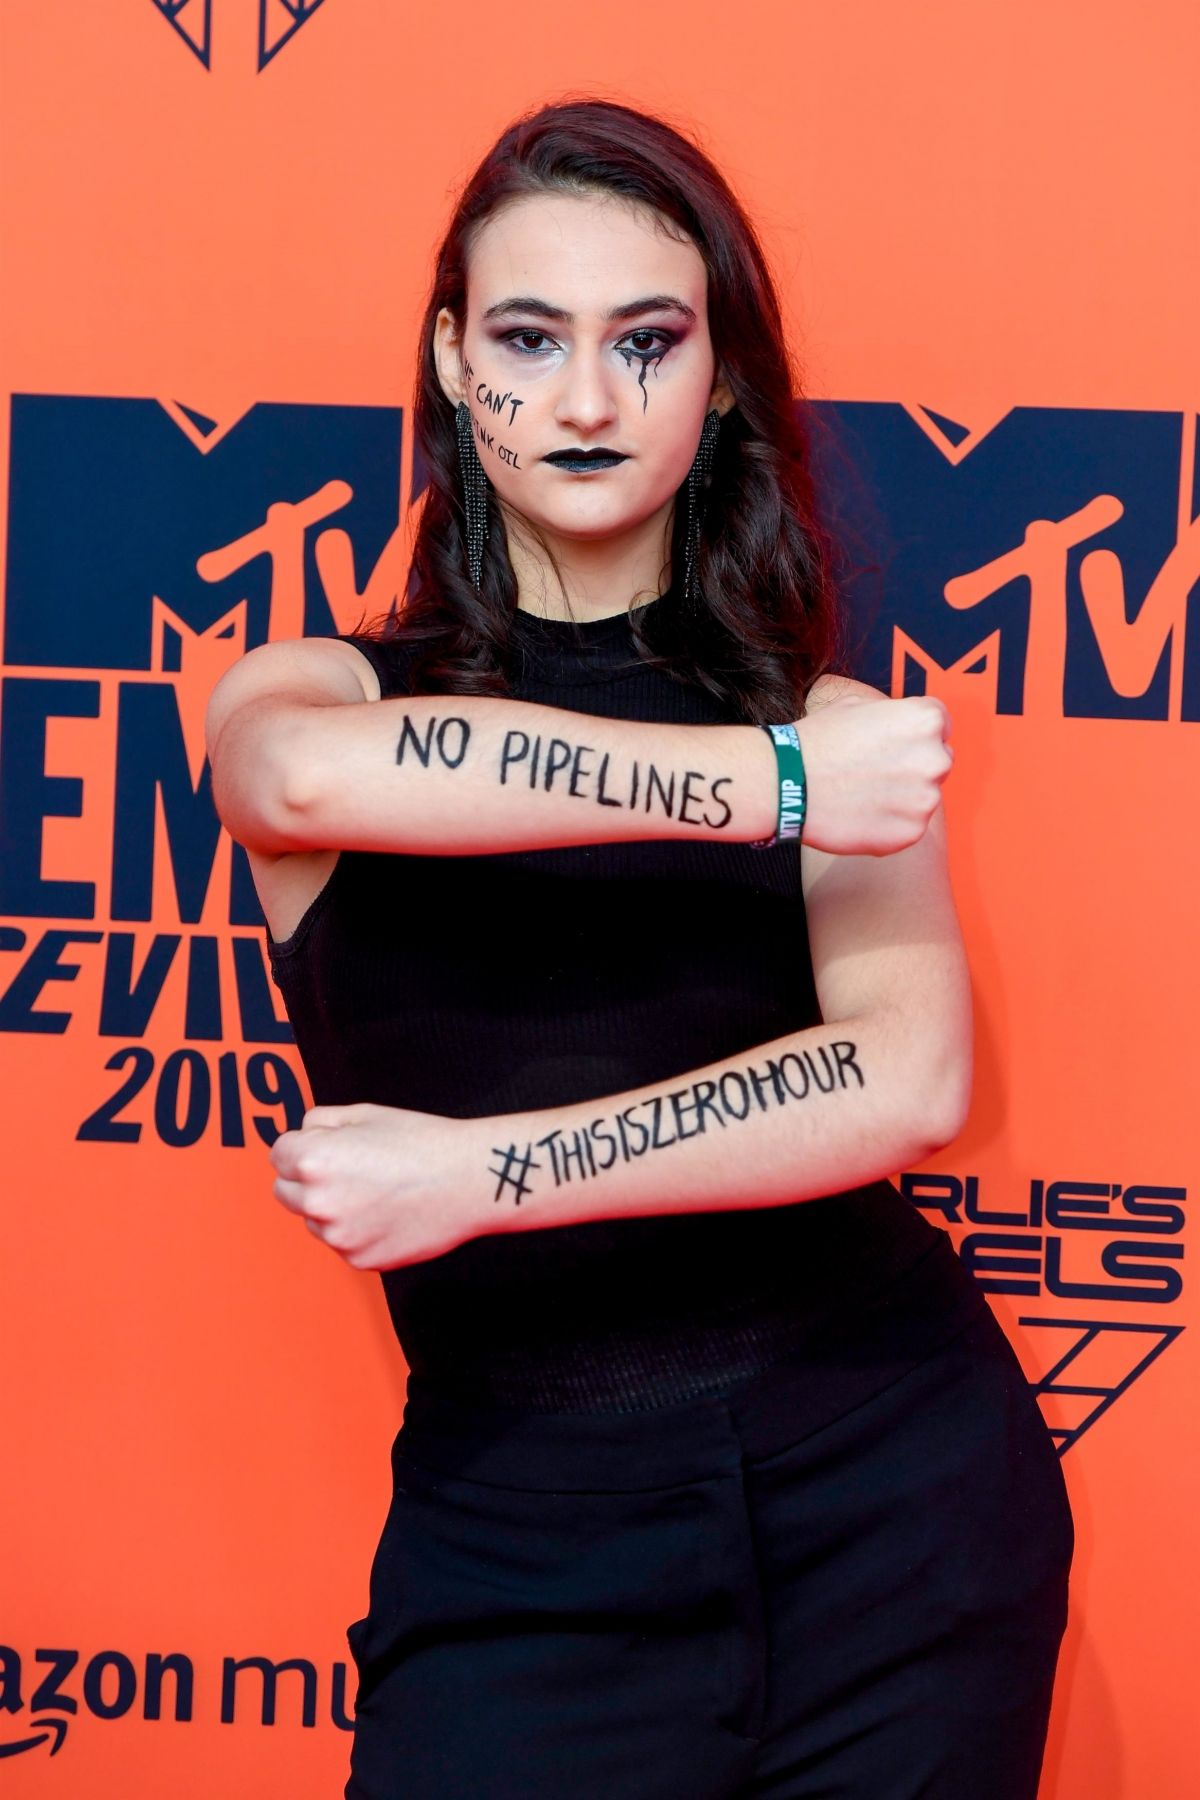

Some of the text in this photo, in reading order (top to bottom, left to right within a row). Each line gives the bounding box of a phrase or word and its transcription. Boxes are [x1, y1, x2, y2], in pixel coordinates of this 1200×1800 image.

[476, 383, 524, 427] CAN'T
[498, 445, 522, 470] OIL
[797, 399, 1200, 723] MTV
[395, 714, 734, 829] NO PIPELINES
[781, 779, 802, 808] VIP
[0, 926, 297, 1044] EVIL
[75, 1047, 305, 1148] 2019
[488, 1041, 865, 1206] #THISISZEROHOUR
[901, 1173, 1187, 1235] RLIE'S
[958, 1232, 1185, 1304] ELS
